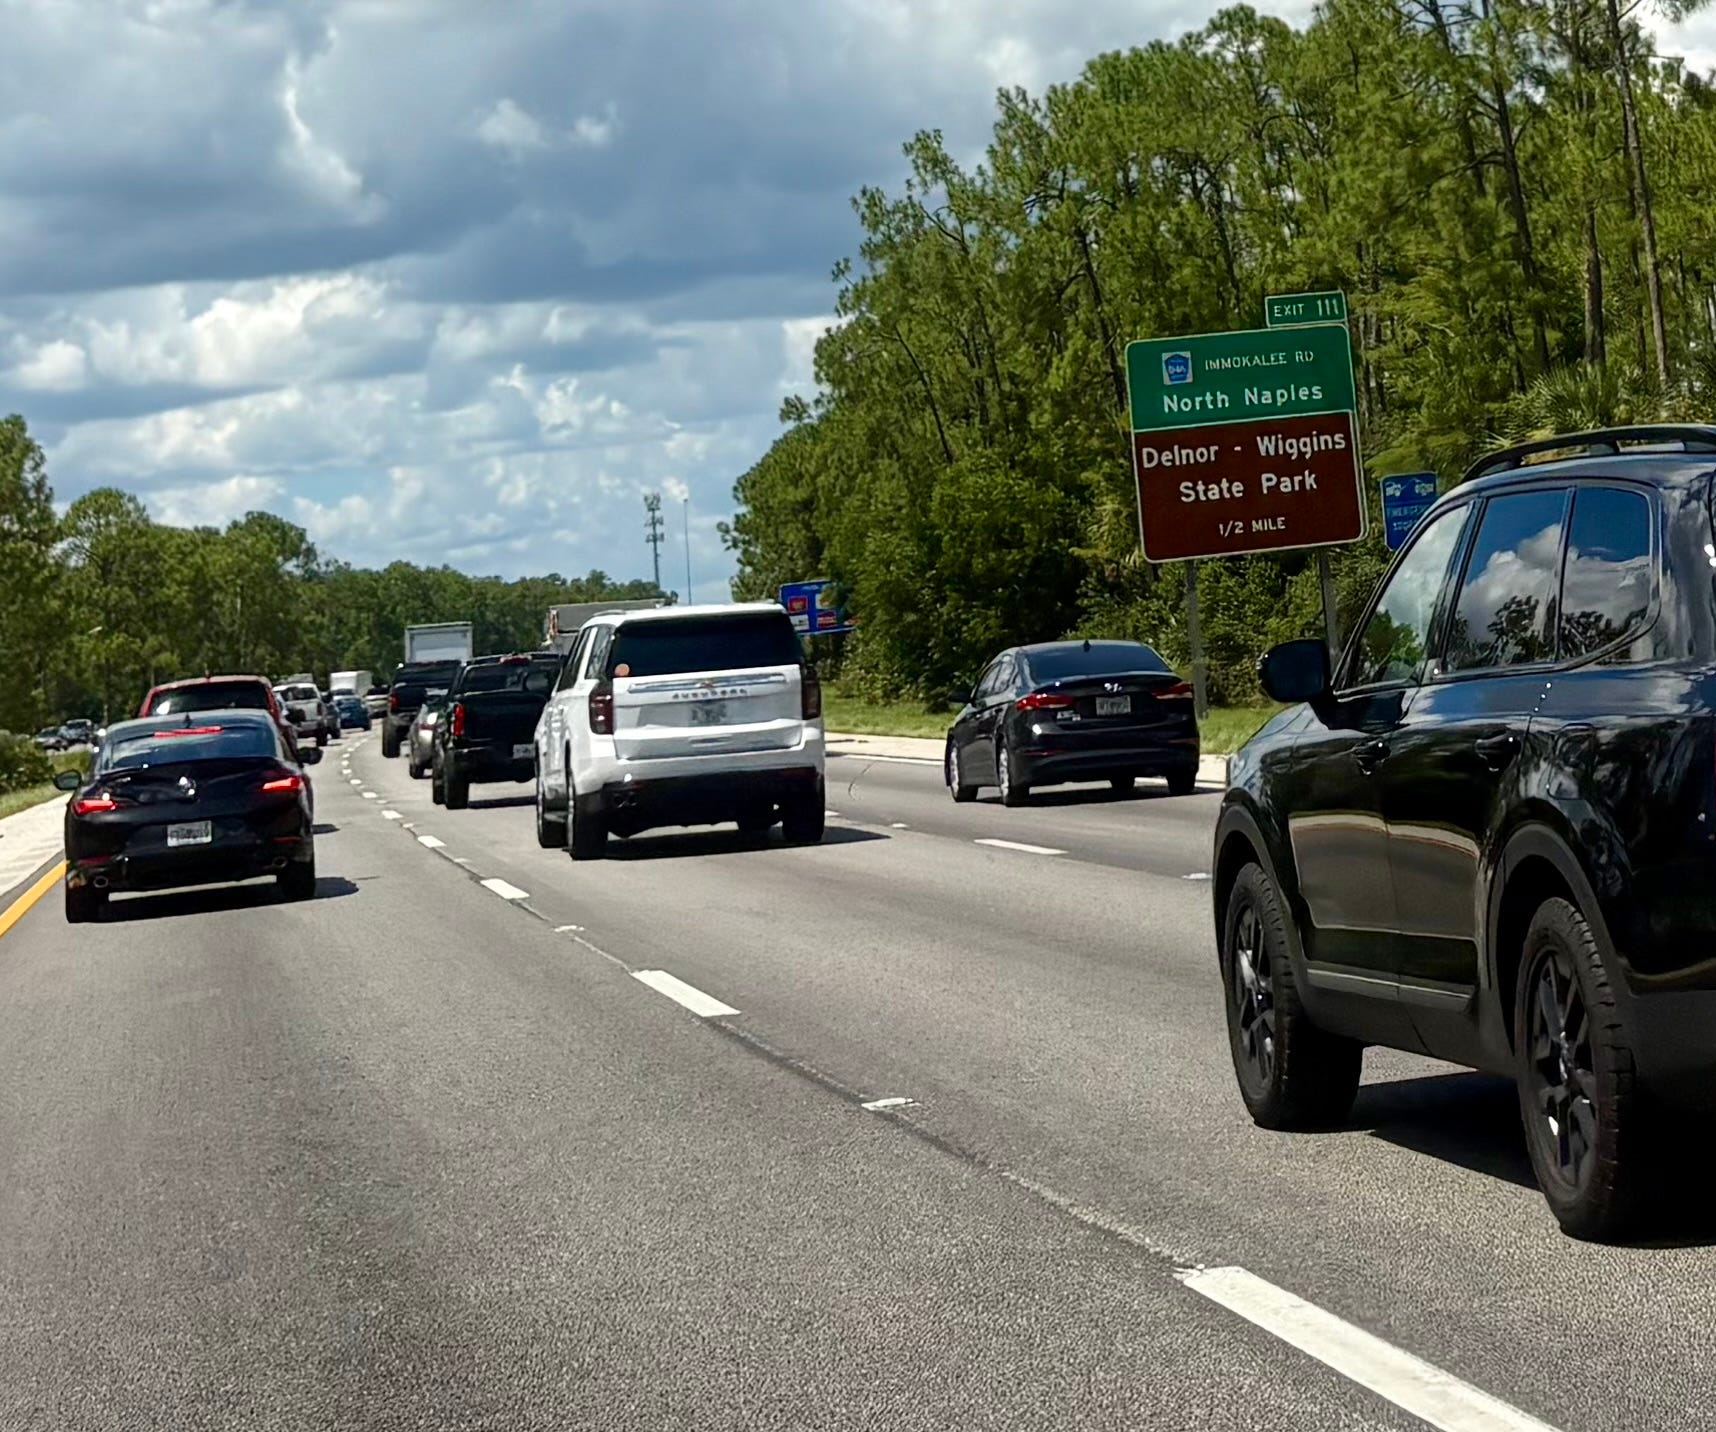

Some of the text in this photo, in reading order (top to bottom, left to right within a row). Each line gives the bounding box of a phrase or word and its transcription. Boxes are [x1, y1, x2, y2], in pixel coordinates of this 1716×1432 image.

[1274, 299, 1340, 317] EXIT 111
[1204, 352, 1287, 371] IMMOKALEE
[1295, 351, 1314, 363] RD
[1163, 384, 1323, 413] North Naples
[1142, 443, 1219, 469] Delnor
[1256, 431, 1346, 460] Wiggins
[1179, 470, 1318, 502] State Park
[1219, 517, 1287, 538] 1/2 MILE
